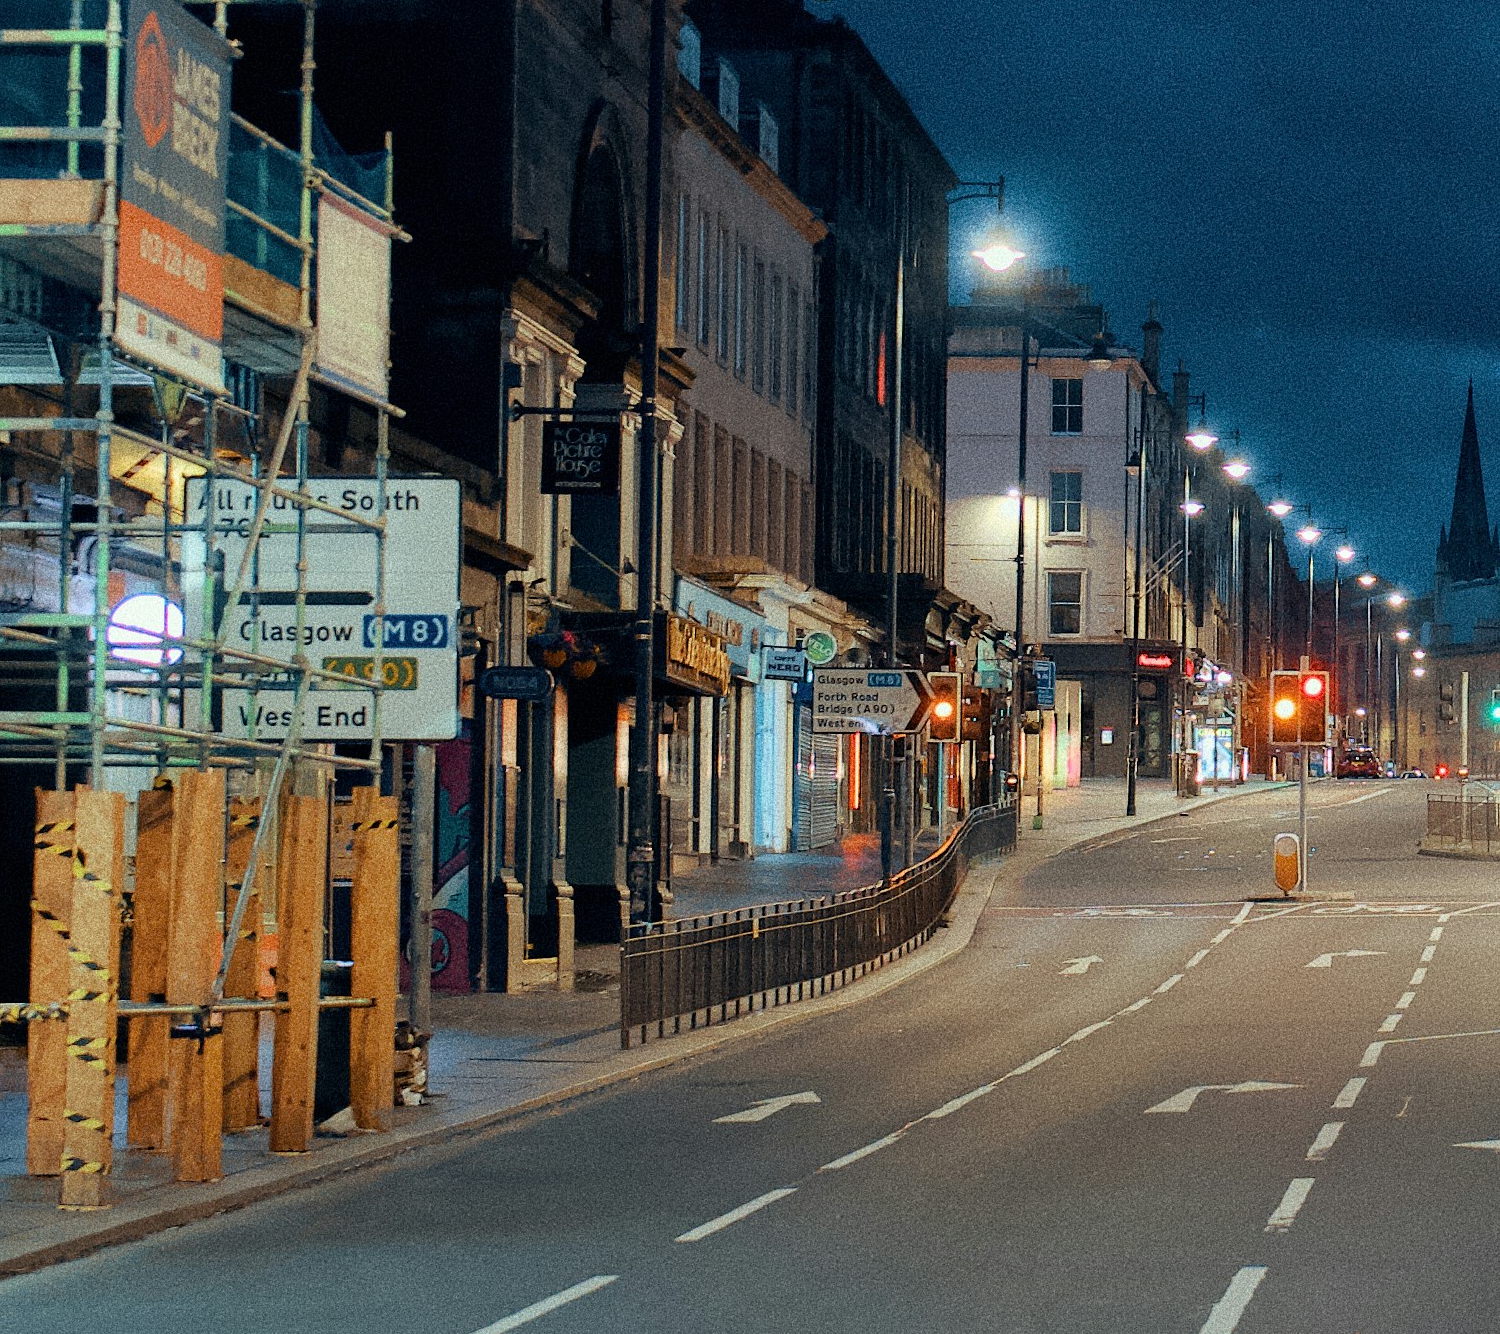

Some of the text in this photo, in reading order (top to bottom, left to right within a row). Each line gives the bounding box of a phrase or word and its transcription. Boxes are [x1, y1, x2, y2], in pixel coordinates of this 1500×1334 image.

[240, 620, 353, 645] Glasgow
[768, 663, 801, 673] NERO
[817, 675, 865, 686] Glasgow
[817, 692, 880, 702] Forth Road
[817, 703, 896, 715] Bridge (A90)
[239, 706, 367, 727] Wes End
[817, 718, 866, 728] West en
